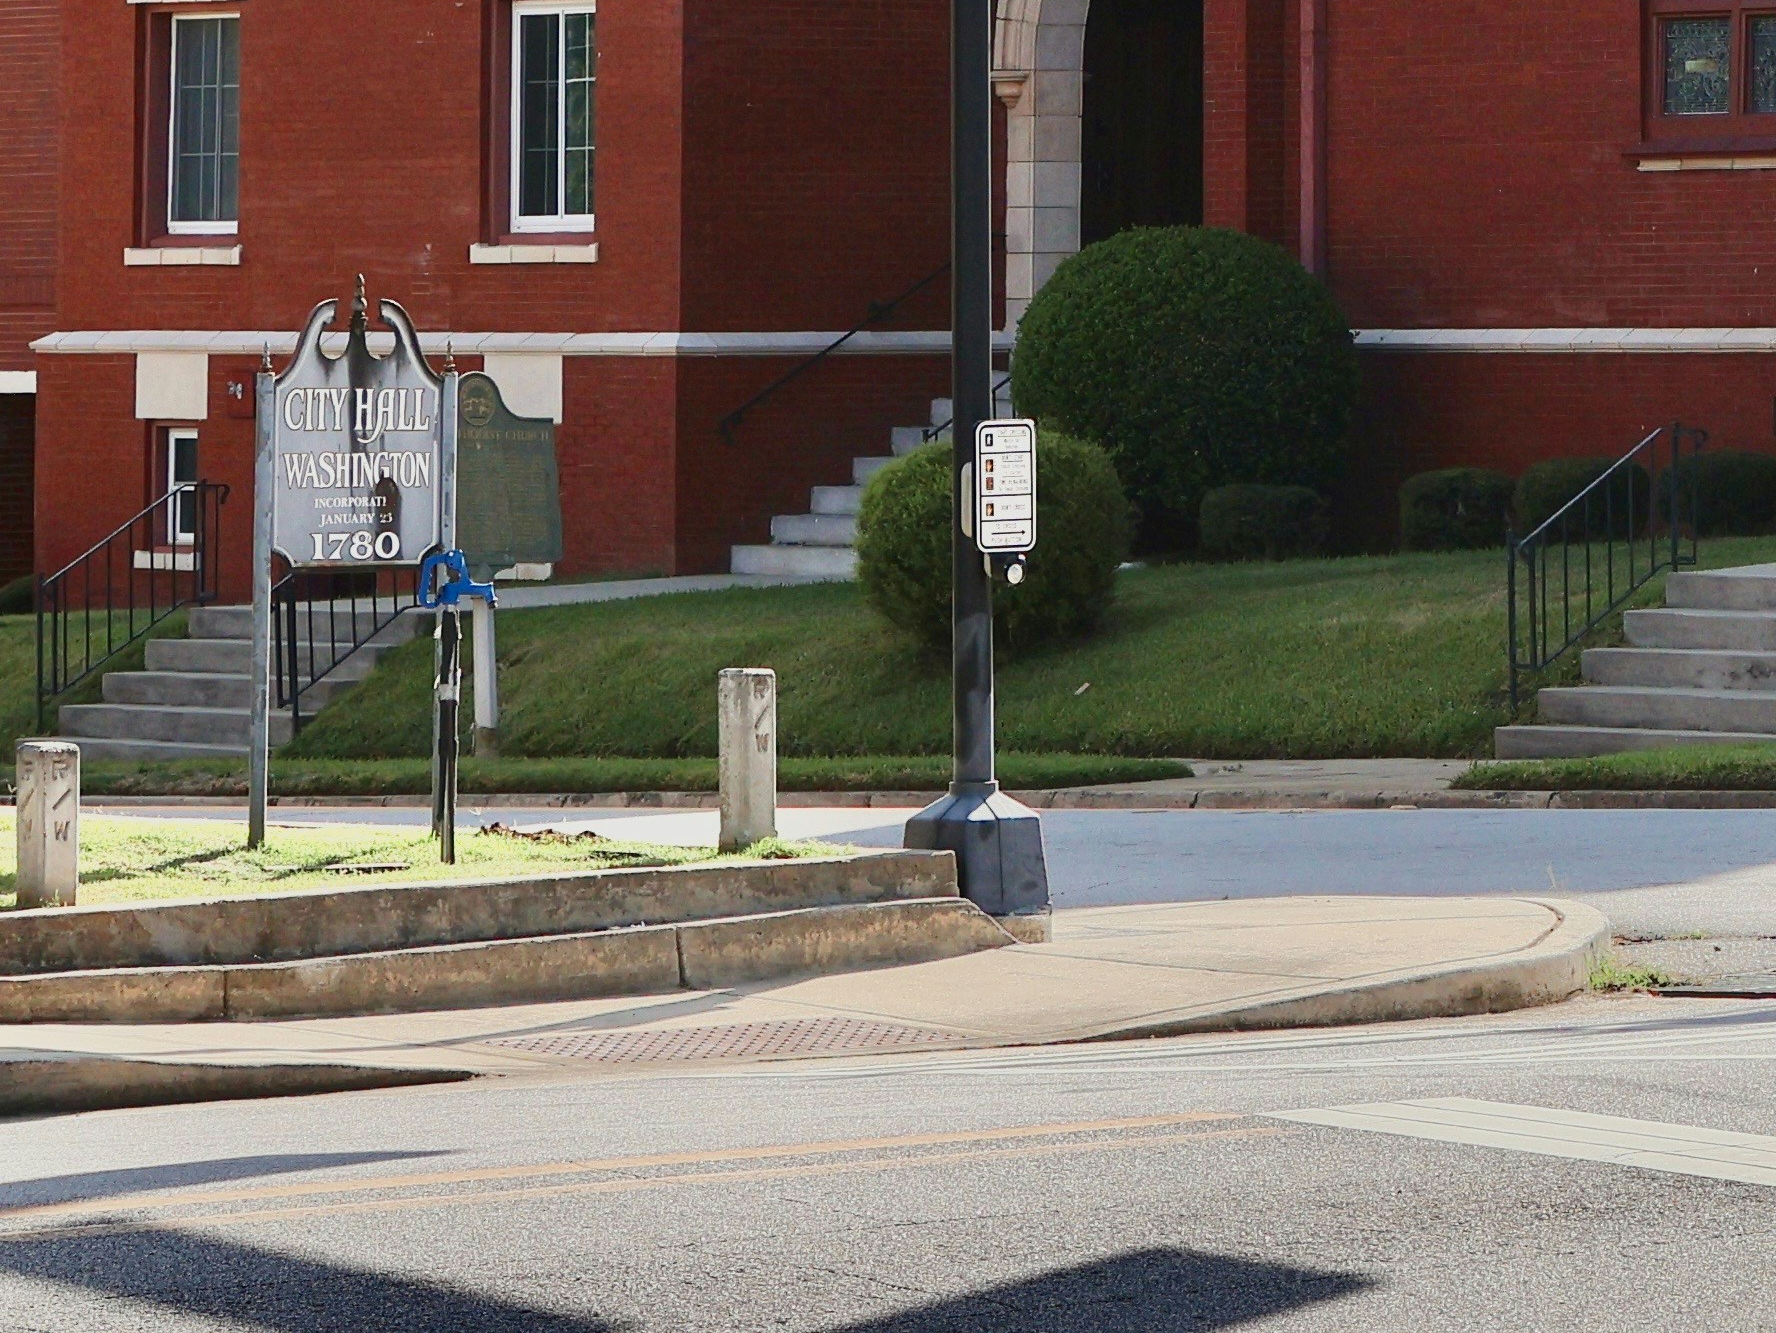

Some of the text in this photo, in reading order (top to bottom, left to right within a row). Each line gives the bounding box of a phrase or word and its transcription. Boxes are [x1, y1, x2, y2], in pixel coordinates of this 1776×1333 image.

[284, 387, 430, 444] CITY HALL
[282, 450, 431, 490] WASHINGTON
[318, 512, 393, 528] JANUARY 23
[310, 530, 400, 561] 1780
